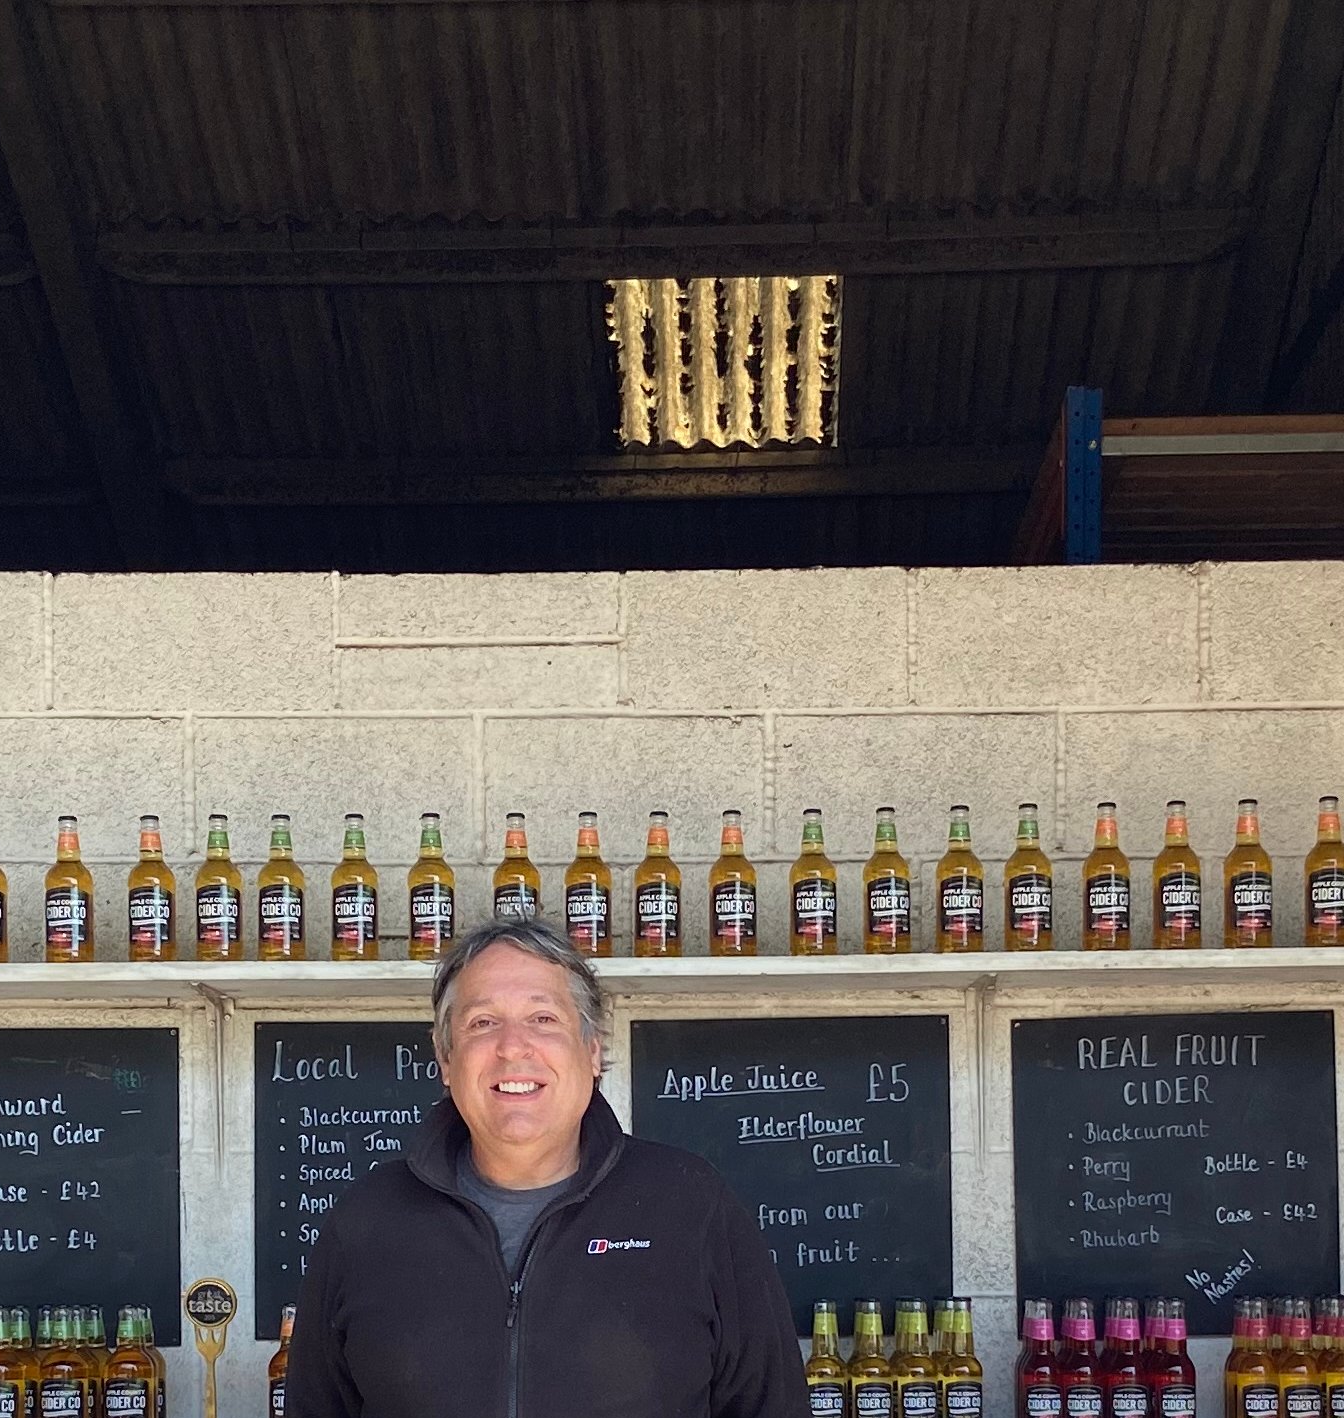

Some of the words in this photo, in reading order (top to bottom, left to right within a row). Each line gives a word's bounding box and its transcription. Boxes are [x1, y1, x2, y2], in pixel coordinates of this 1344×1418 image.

[272, 1040, 358, 1082] Local
[1077, 1036, 1157, 1070] REAL
[1175, 1034, 1266, 1067] FRUIT
[664, 1066, 734, 1100] Apple
[746, 1064, 819, 1090] Juice
[866, 1063, 910, 1103] £5
[1124, 1075, 1213, 1106] CIDER
[299, 1105, 422, 1128] Blackcurrant
[738, 1112, 865, 1140] Elderflower
[53, 1122, 105, 1146] Cider
[298, 1135, 346, 1156] Plum
[364, 1129, 402, 1153] Jam
[1082, 1119, 1210, 1144] Blackcurrant
[813, 1140, 893, 1166] Cordial
[1204, 1153, 1260, 1175] Bottle
[299, 1164, 355, 1182] Spiced
[1082, 1156, 1131, 1182] Perry
[60, 1180, 102, 1201] £42
[298, 1193, 338, 1214] Appl
[1082, 1191, 1172, 1215] Raspberry
[758, 1204, 807, 1230] from
[825, 1201, 863, 1219] our
[1216, 1207, 1253, 1225] Case
[67, 1229, 97, 1250] £4
[608, 1238, 651, 1250] berghaus
[1081, 1225, 1159, 1248] Rhubarb
[1185, 1268, 1210, 1290] No
[188, 1300, 232, 1313] taste
